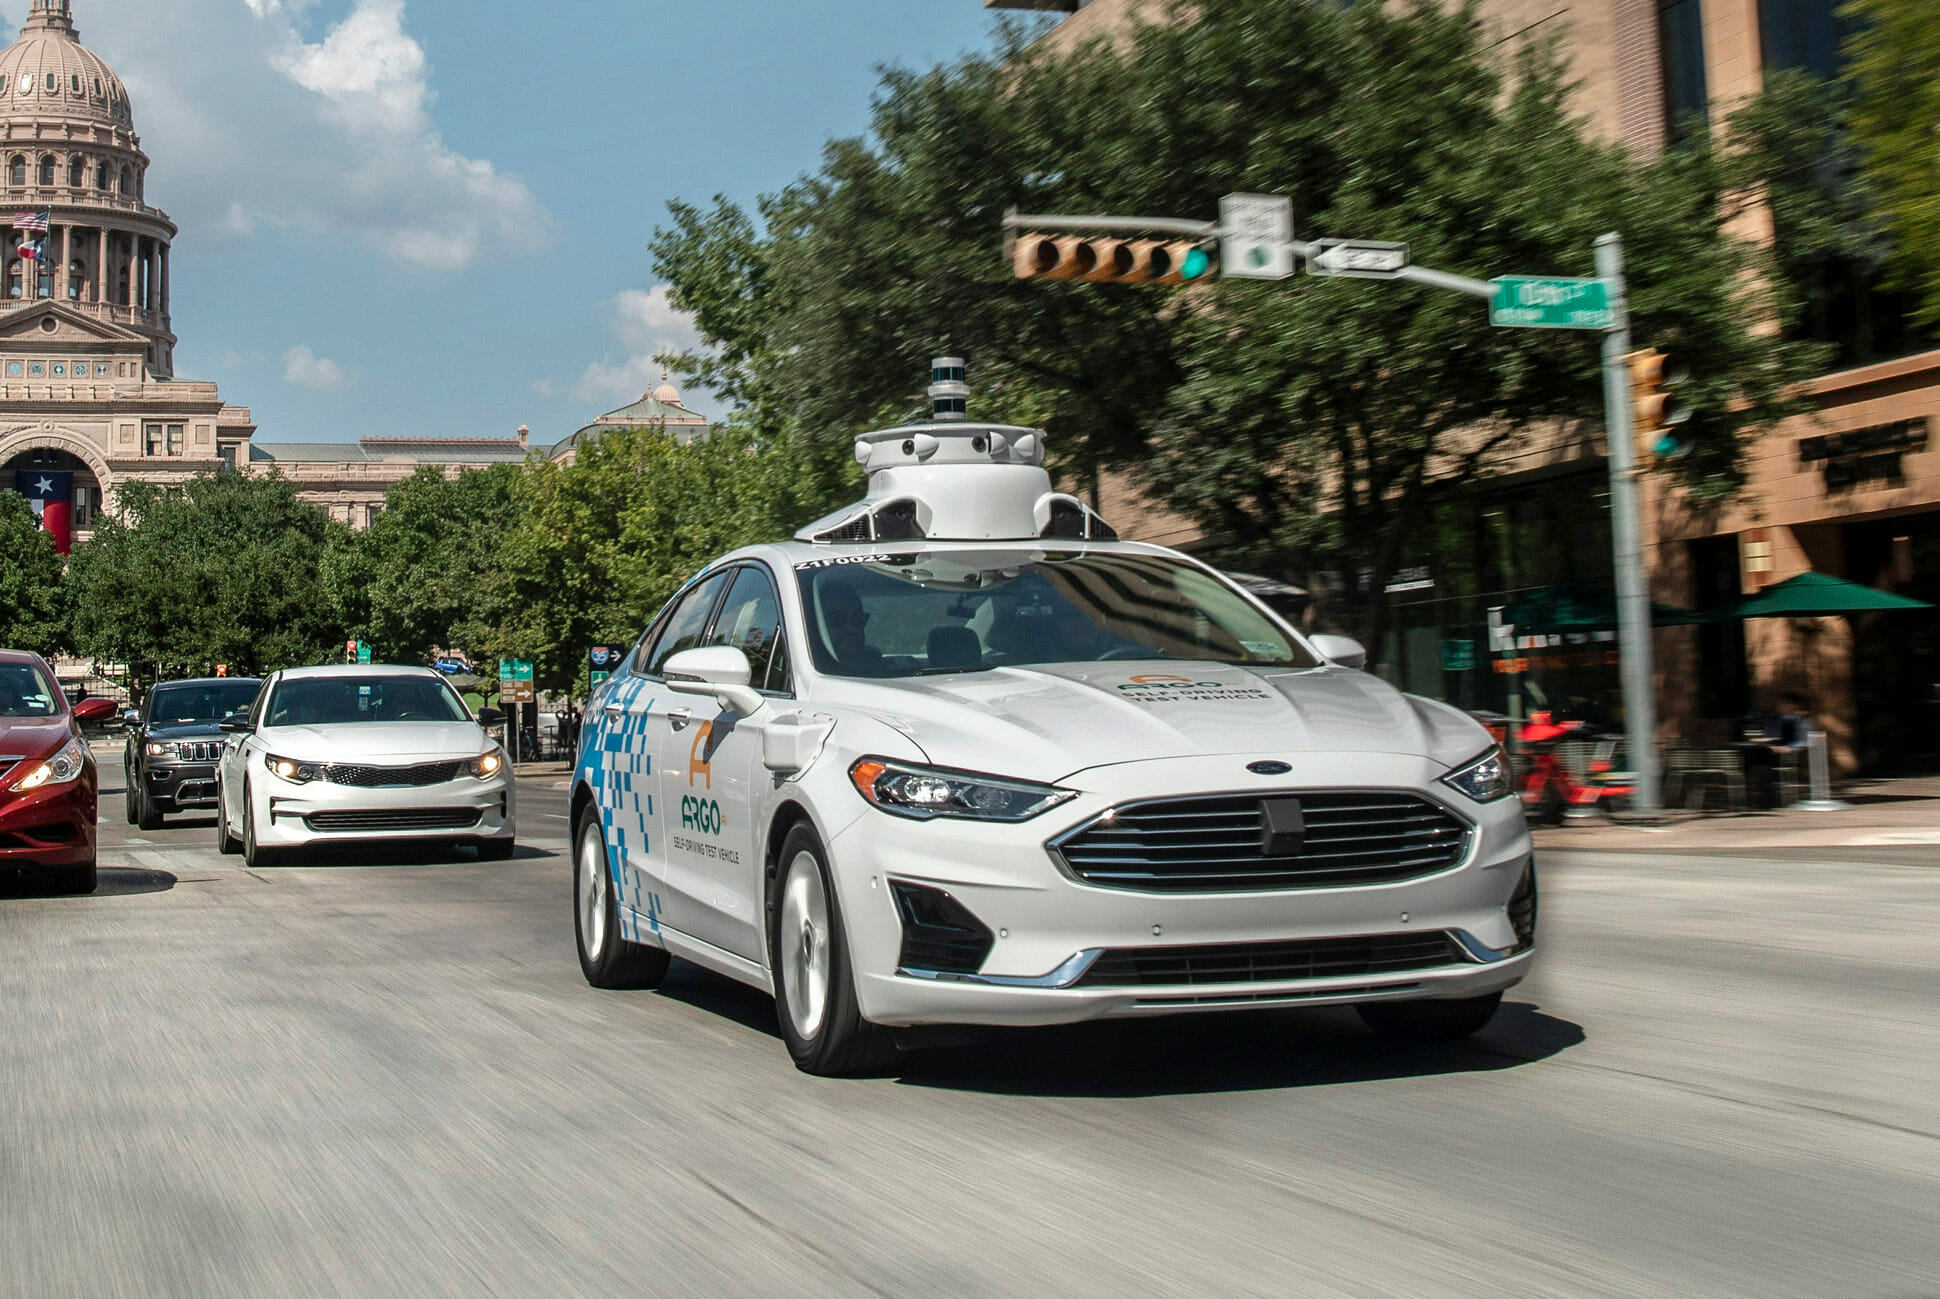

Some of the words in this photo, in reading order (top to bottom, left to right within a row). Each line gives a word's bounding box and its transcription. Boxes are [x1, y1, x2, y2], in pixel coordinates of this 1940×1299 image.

[681, 794, 720, 836] ARGO
[673, 835, 705, 856] SELF-DRIVING
[705, 844, 718, 860] TEST
[718, 847, 740, 865] VEHICLE
